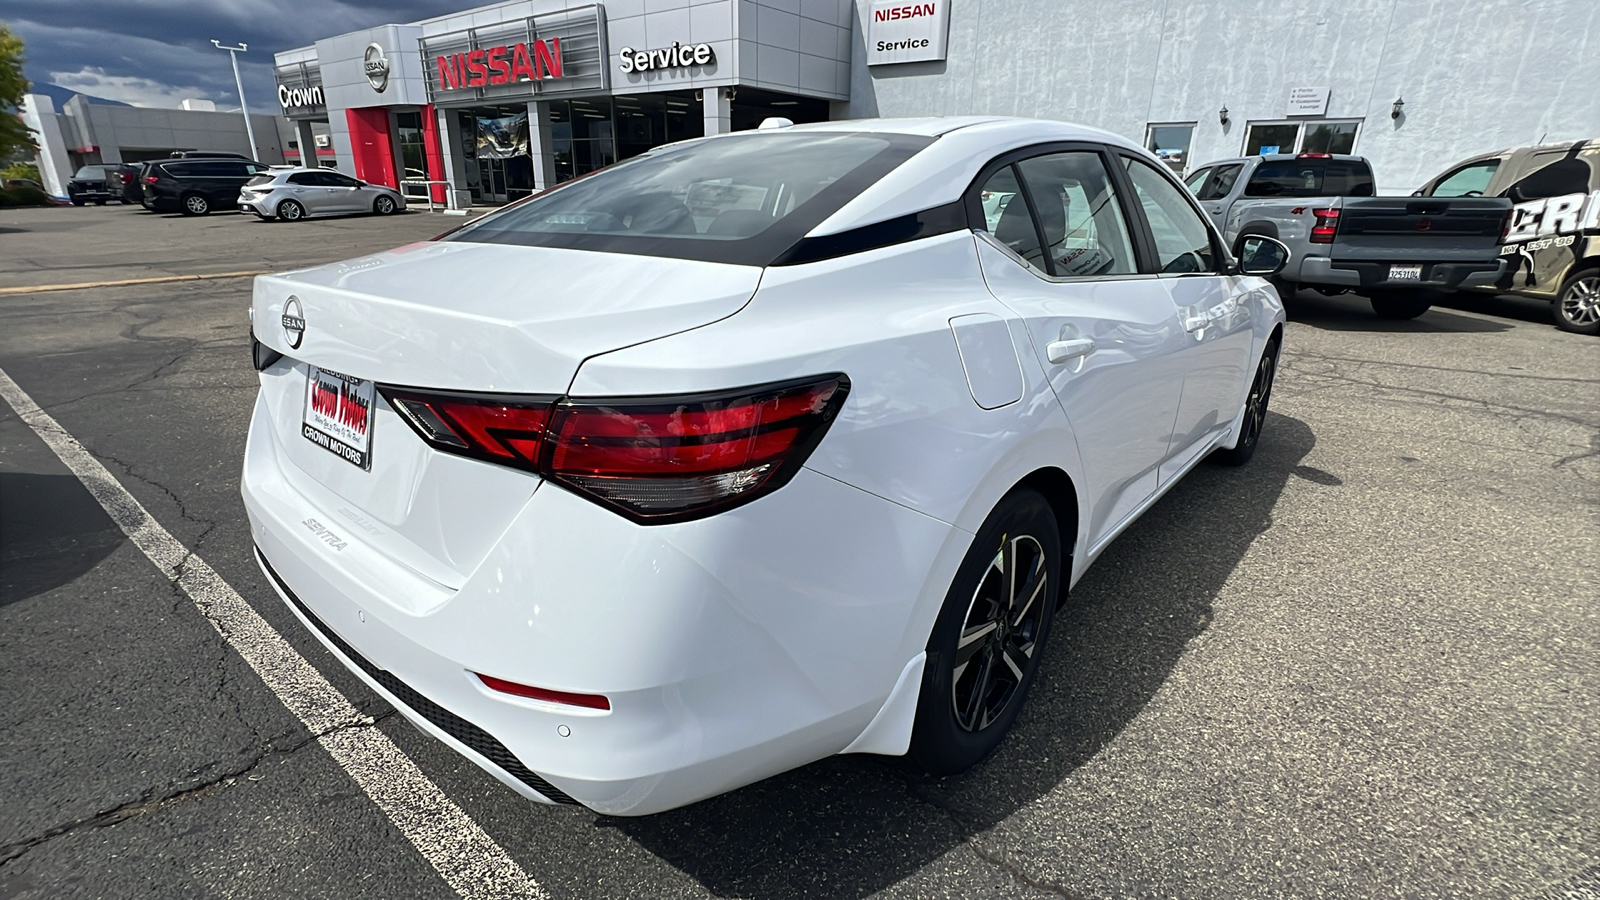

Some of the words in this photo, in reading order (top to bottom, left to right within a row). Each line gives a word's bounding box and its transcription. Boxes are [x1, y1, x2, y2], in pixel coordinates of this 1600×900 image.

[875, 3, 935, 22] NISSAN
[619, 41, 711, 73] Service
[876, 38, 929, 52] Service
[437, 37, 562, 90] NISSAN
[278, 84, 323, 109] Crown
[1526, 238, 1552, 252] EST
[1553, 235, 1576, 248] '96
[283, 316, 304, 330] SSAN
[311, 372, 338, 420] Crown
[304, 425, 330, 448] CROWN
[329, 438, 361, 465] MOTORS
[301, 517, 348, 552] SENTRA
